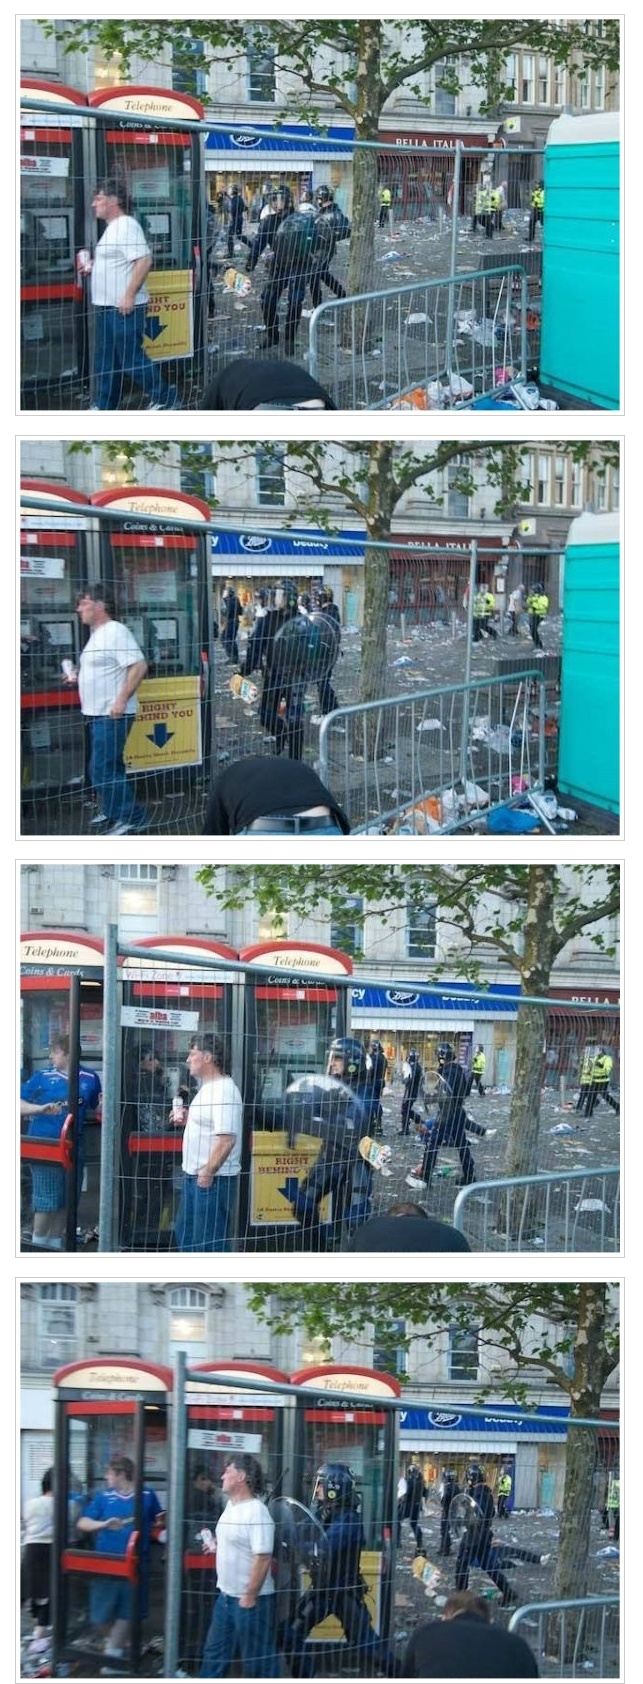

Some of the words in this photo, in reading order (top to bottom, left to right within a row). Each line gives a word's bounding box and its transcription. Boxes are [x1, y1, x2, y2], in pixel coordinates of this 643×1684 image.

[125, 100, 173, 112] Telephone
[165, 303, 186, 311] YOU
[128, 502, 178, 515] Telephone
[123, 521, 148, 531] Coins
[142, 703, 177, 712] RIGHT
[172, 709, 193, 718] YOU
[24, 945, 79, 958] Telephone
[273, 956, 321, 968] Telephone
[57, 967, 85, 977] Cards
[275, 1157, 308, 1166] RIGHT
